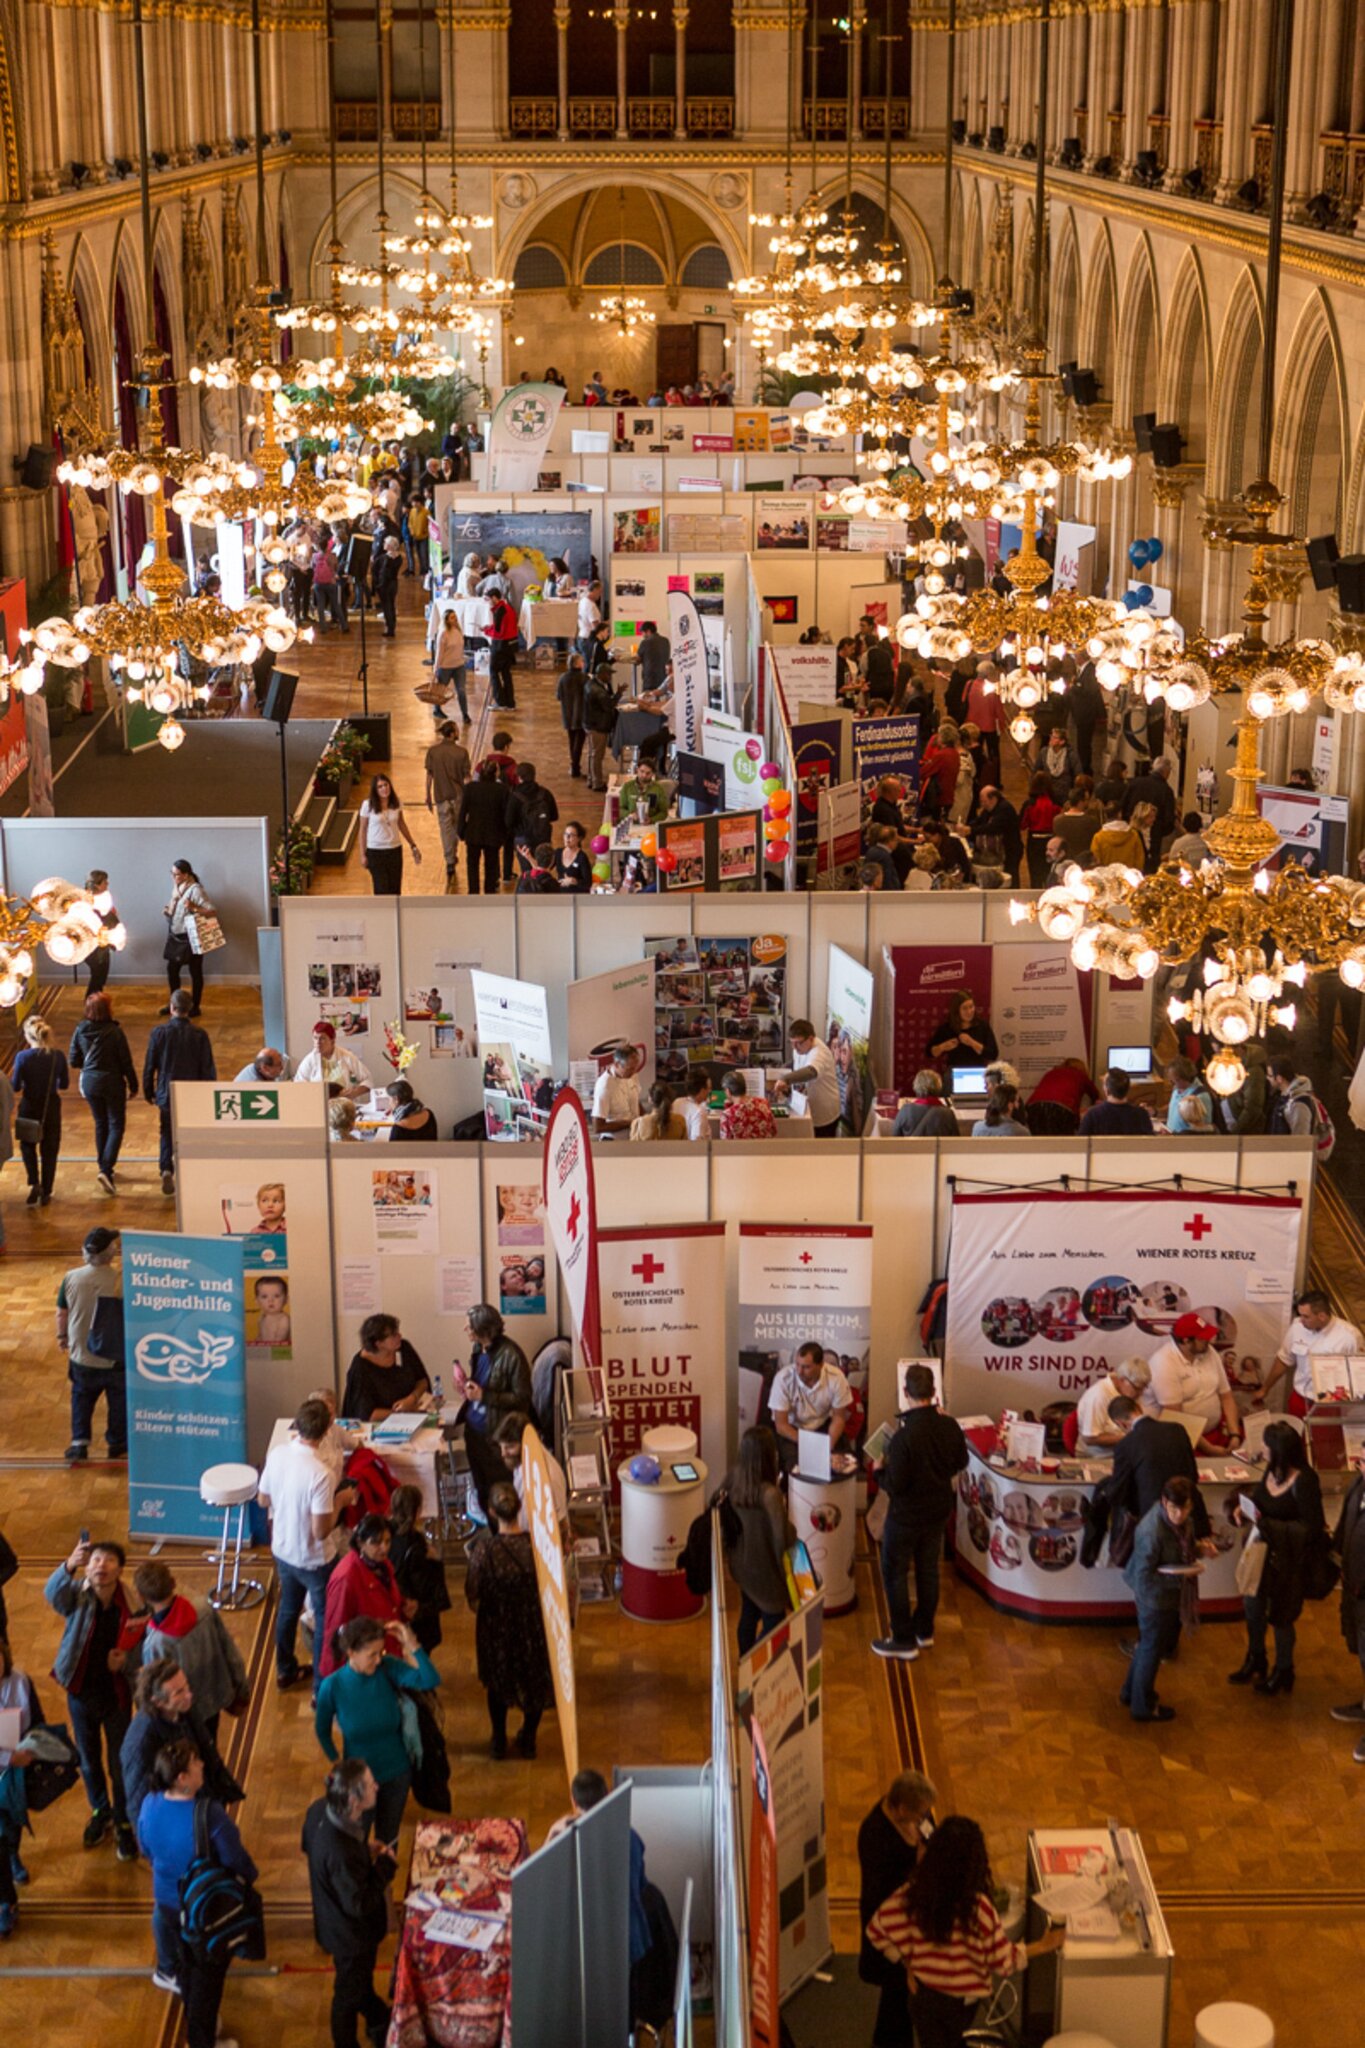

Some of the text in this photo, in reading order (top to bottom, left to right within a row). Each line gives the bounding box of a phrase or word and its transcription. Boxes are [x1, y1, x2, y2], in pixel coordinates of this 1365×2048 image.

[130, 1252, 191, 1270] Wiener
[1136, 1249, 1256, 1261] WIENER ROTES KREUZ
[131, 1272, 233, 1293] Kinder- und
[131, 1292, 232, 1312] Jugendhilfe
[623, 1296, 673, 1306] ROTES KREUZ
[754, 1312, 783, 1326] AUS
[786, 1312, 824, 1327] LIEBE
[754, 1326, 839, 1341] MENSCHEN.
[608, 1355, 692, 1378] BLUT
[983, 1355, 1115, 1373] WIR SIND DA,
[607, 1380, 692, 1397] SPENDEN
[1058, 1374, 1091, 1390] UM
[609, 1400, 693, 1420] RETTET
